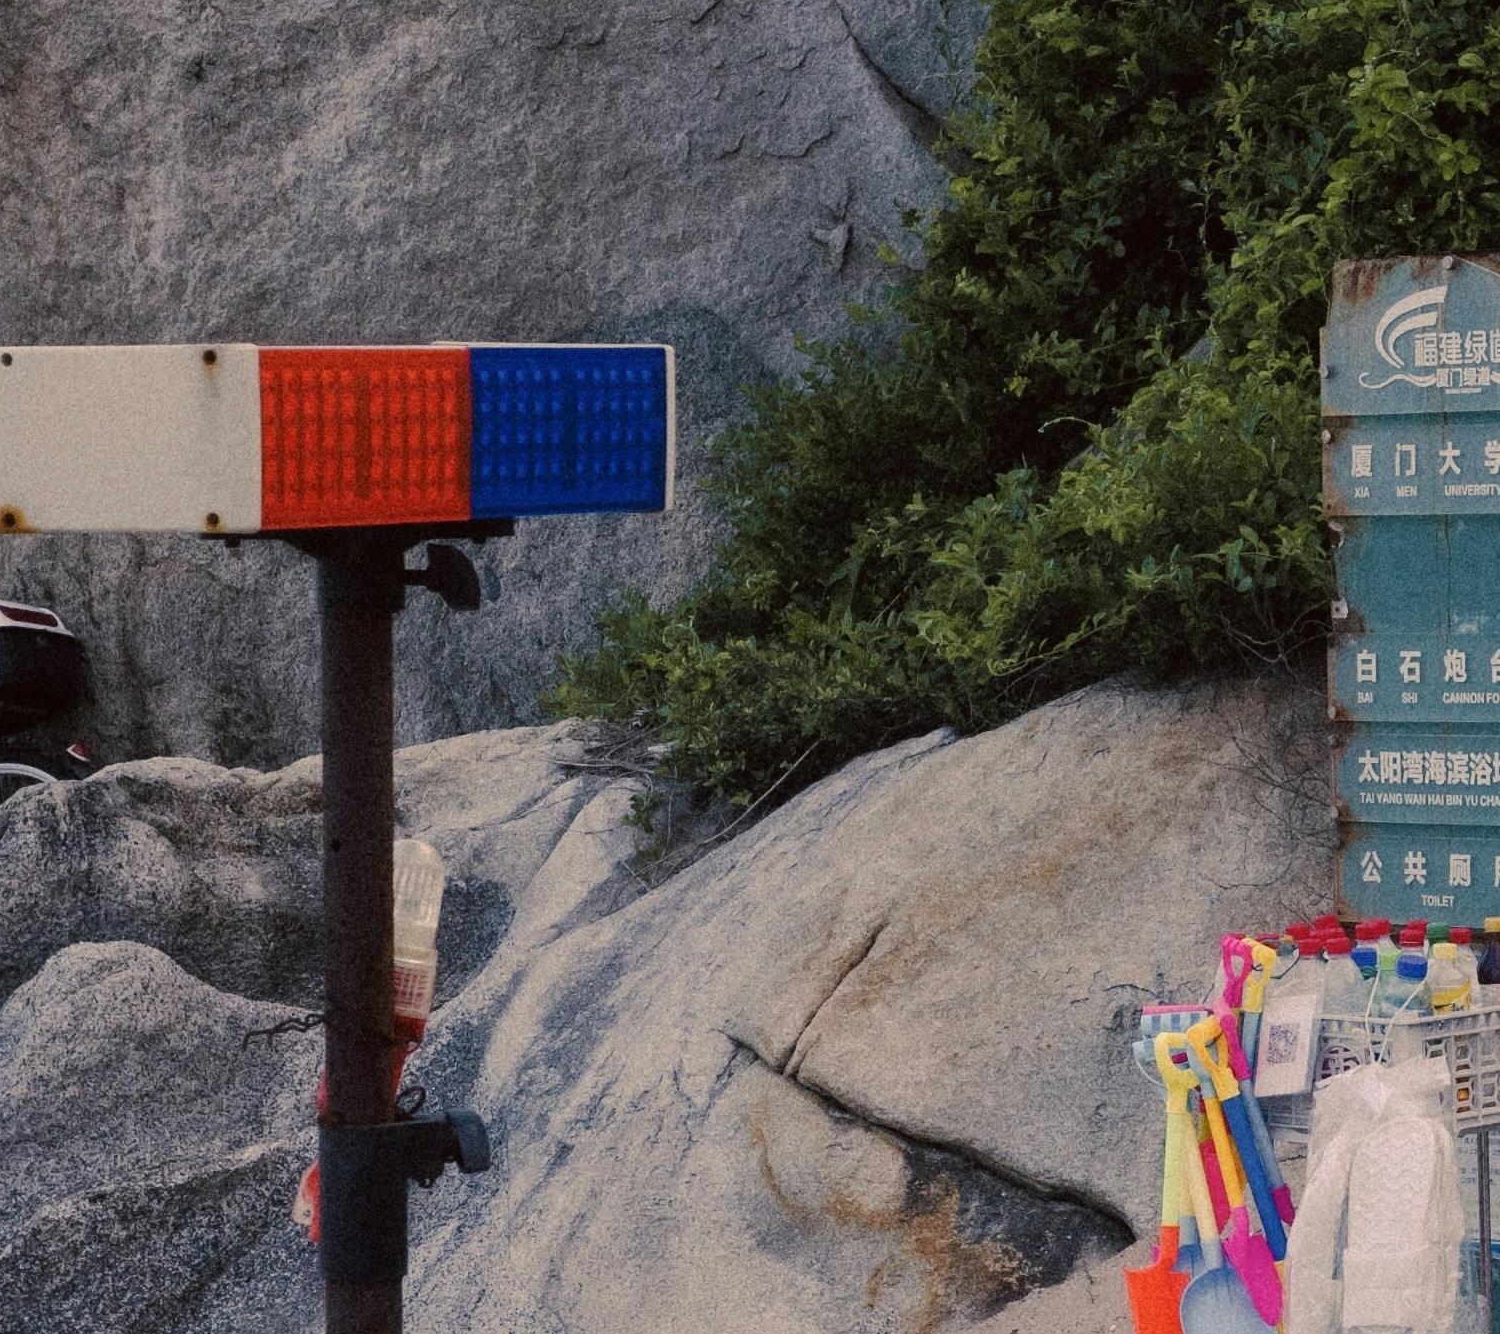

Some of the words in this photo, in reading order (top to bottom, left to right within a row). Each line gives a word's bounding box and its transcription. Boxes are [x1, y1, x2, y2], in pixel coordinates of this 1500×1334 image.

[1436, 367, 1491, 388] 厦门绿道
[1354, 485, 1370, 499] XIA
[1396, 485, 1417, 498] MEN
[1357, 692, 1373, 704] BAI
[1401, 692, 1418, 704] SHI
[1442, 692, 1485, 704] CANNON
[1360, 793, 1375, 804] TAI
[1377, 793, 1403, 805] YANG
[1404, 793, 1426, 805] WAN
[1428, 794, 1444, 805] HAI
[1445, 794, 1462, 806] BIN
[1465, 795, 1478, 806] YU
[1421, 895, 1455, 907] TOILET
